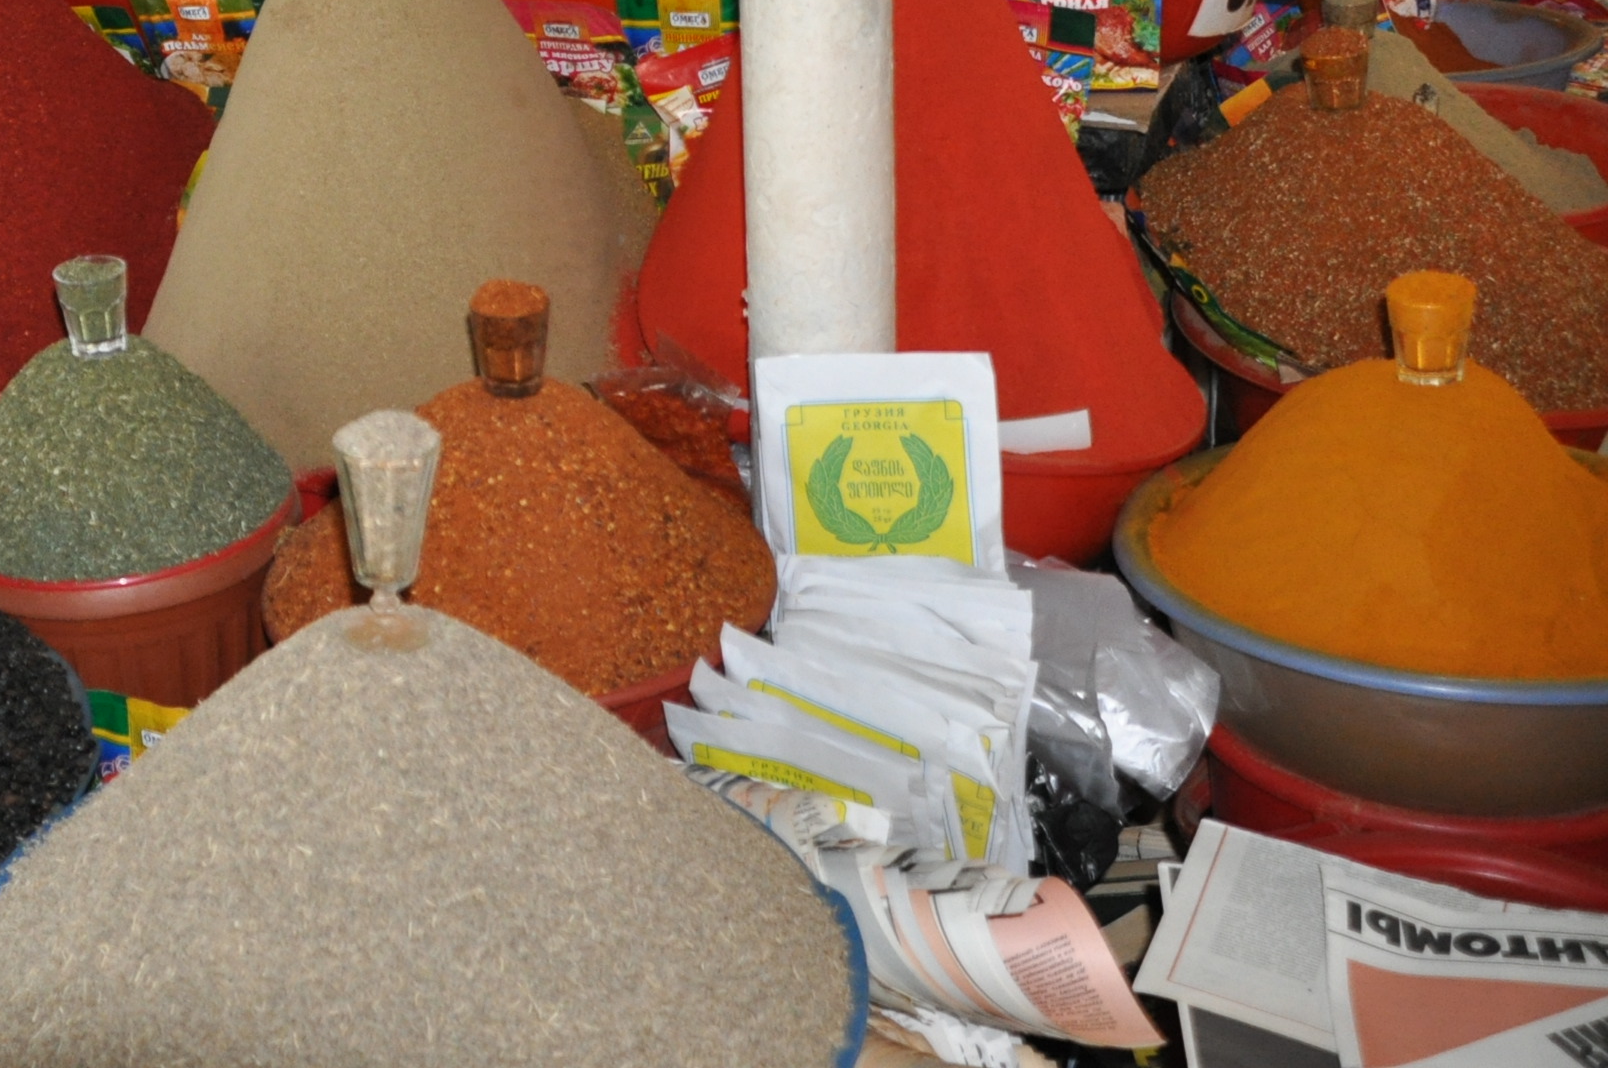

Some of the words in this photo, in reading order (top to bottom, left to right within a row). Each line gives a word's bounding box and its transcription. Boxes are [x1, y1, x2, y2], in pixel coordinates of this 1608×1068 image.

[671, 14, 707, 25] ОМЕГА
[540, 41, 590, 51] ПРИПРАВА
[544, 58, 614, 77] аршу
[700, 65, 728, 83] ОМЕГ
[843, 407, 905, 419] ГРУЗИЯ
[841, 420, 909, 432] GEORGIA
